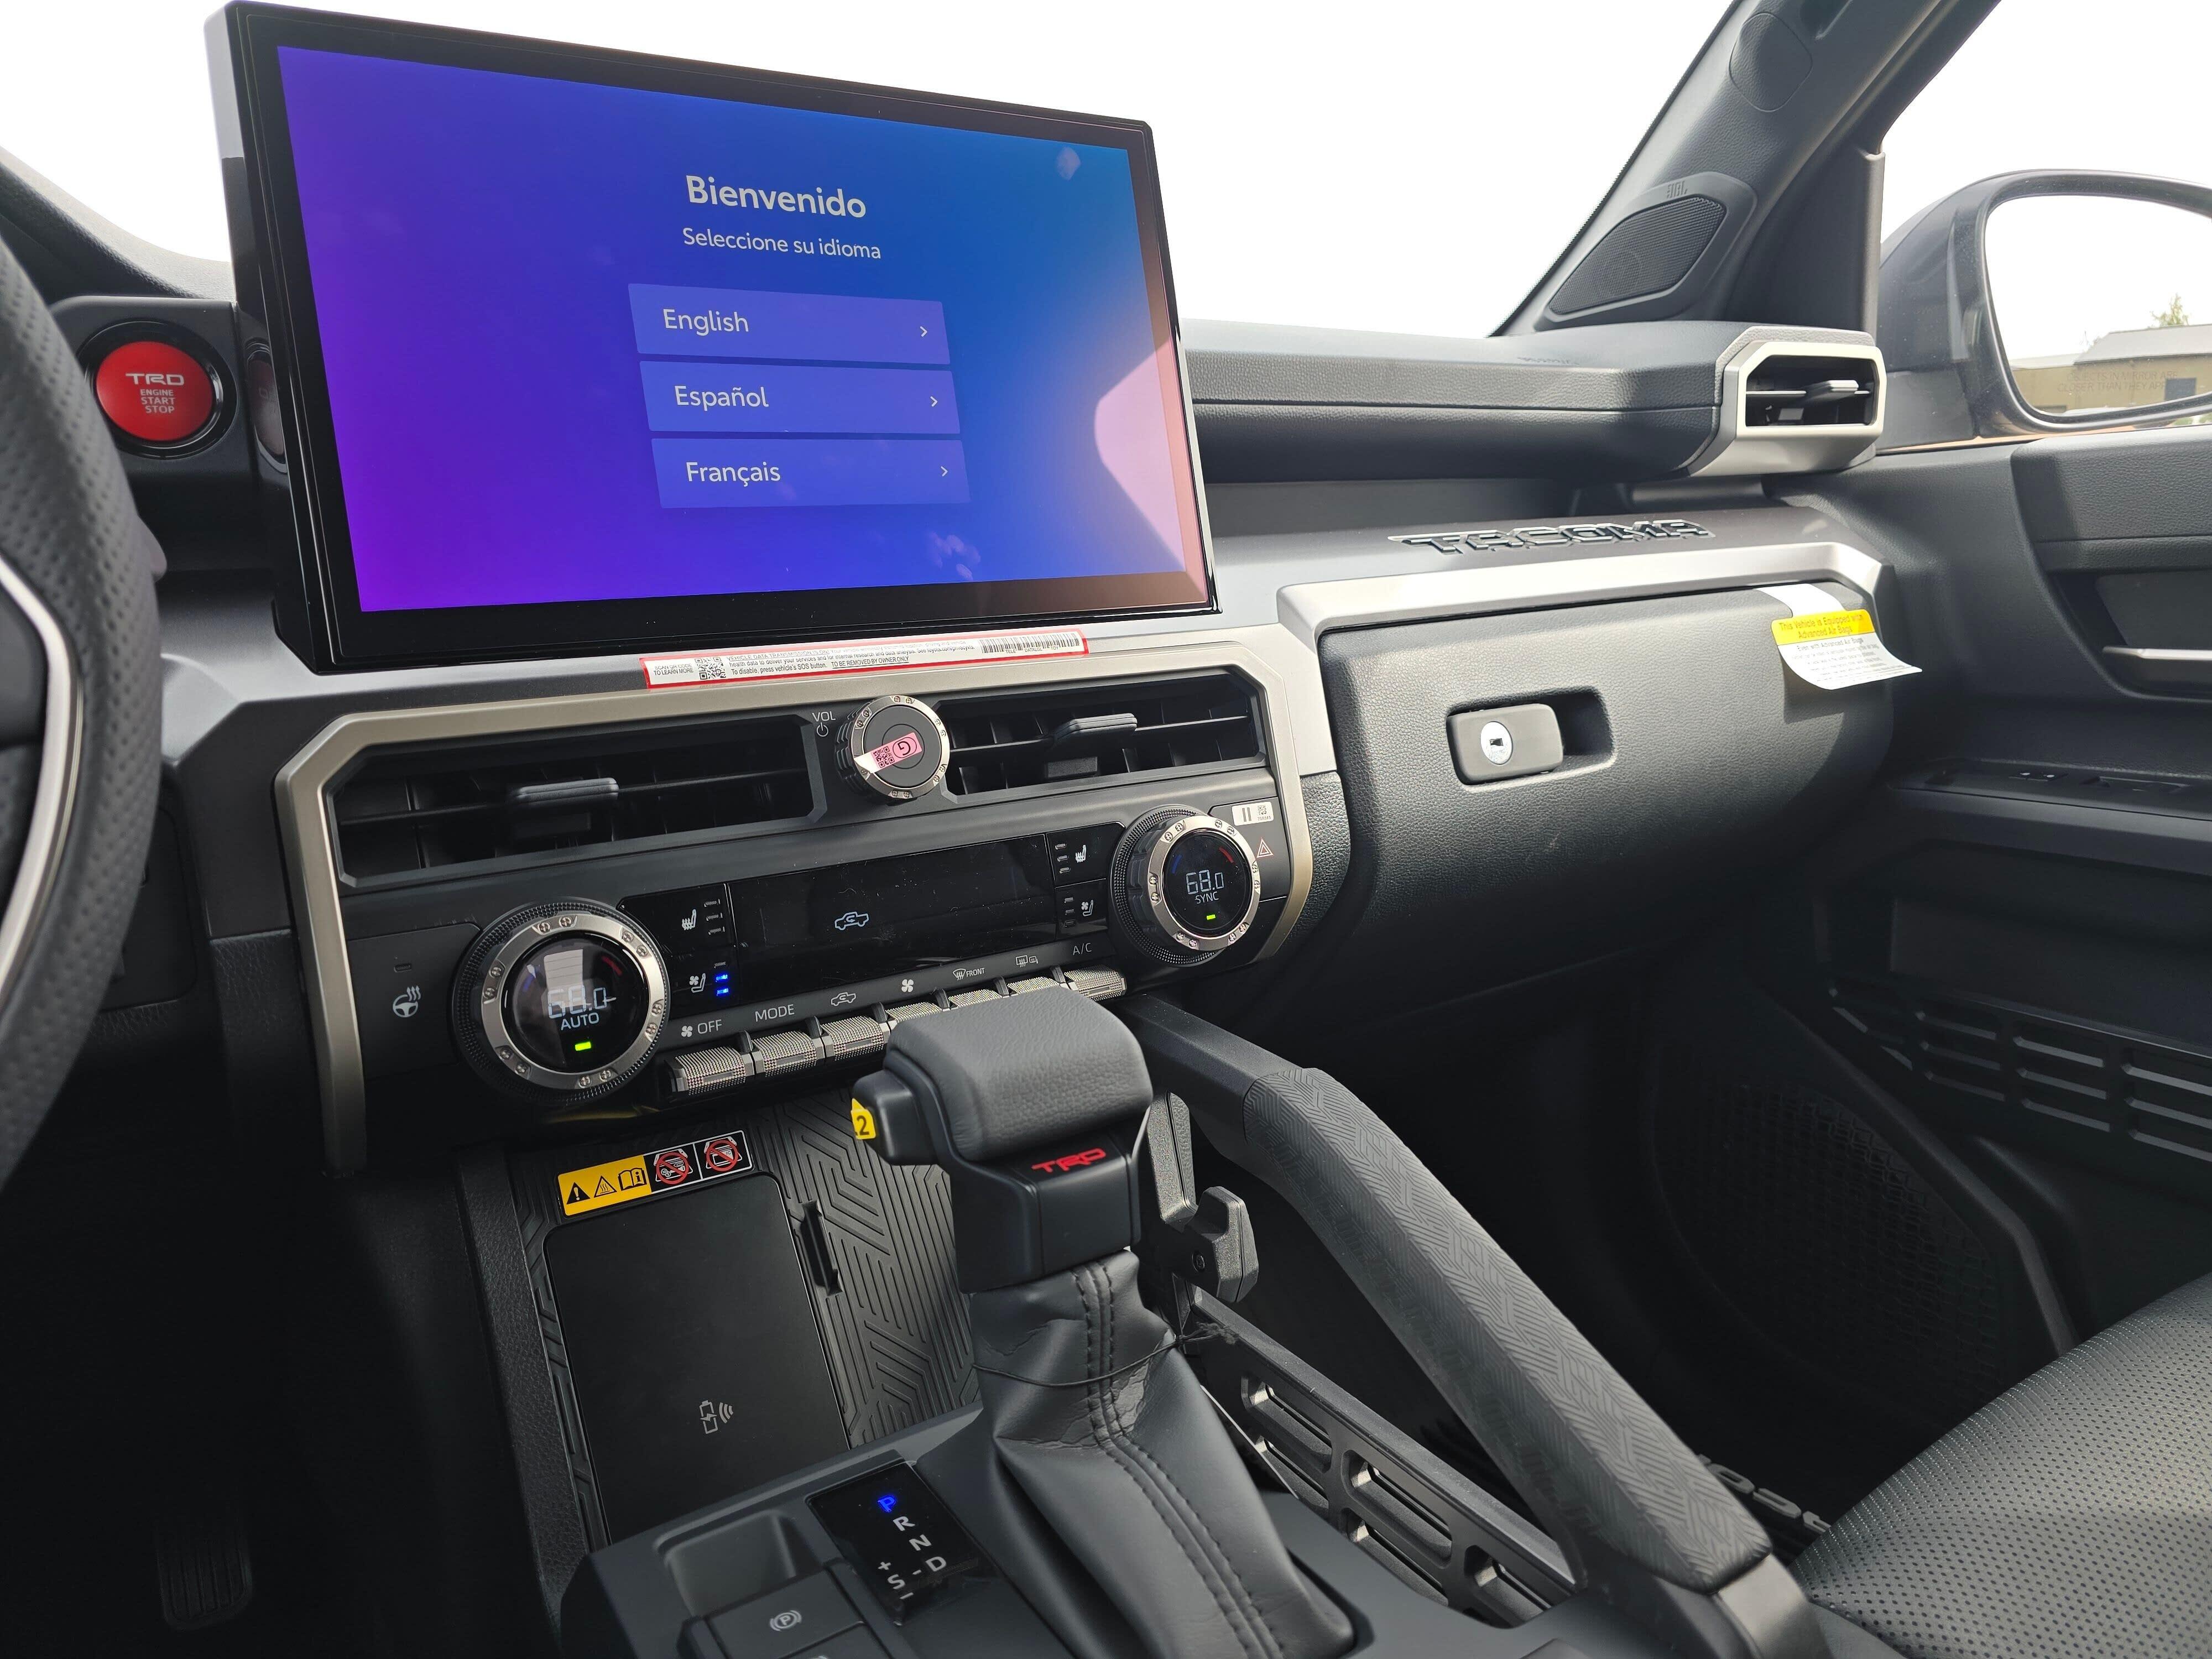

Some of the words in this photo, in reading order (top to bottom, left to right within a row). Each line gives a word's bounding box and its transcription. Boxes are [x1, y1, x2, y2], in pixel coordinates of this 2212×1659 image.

[685, 175, 867, 218] Bienvenido
[682, 227, 789, 253] Seleccione
[793, 239, 815, 255] su
[818, 240, 881, 259] idioma
[663, 309, 749, 336] English
[125, 373, 185, 386] TRD
[139, 388, 174, 397] ENGINE
[674, 385, 769, 411] Español
[140, 397, 176, 405] START
[145, 405, 175, 414] STOP
[686, 461, 781, 487] Français
[1387, 519, 1716, 554] TACOMA
[1778, 622, 1793, 631] This
[1794, 620, 1816, 629] Vehicle
[1798, 628, 1828, 639] Advanced
[1828, 627, 1837, 635] Air
[760, 666, 774, 674] press
[774, 664, 797, 672] vehicle's
[812, 711, 836, 722] VOL
[897, 740, 911, 756] G
[1186, 869, 1225, 895] 68.0
[1194, 891, 1219, 905] SYNC
[1072, 942, 1093, 956] A/C
[966, 966, 986, 978] FRONT
[547, 985, 607, 1019] 68.0
[754, 1004, 795, 1022] MODE
[561, 1012, 599, 1031] AUTO
[697, 1019, 723, 1034] OFF
[855, 1114, 870, 1136] 2
[1031, 1147, 1107, 1173] TRD
[878, 1494, 898, 1513] P
[893, 1516, 916, 1531] R
[909, 1534, 932, 1551] N
[926, 1556, 947, 1572] D
[887, 1574, 906, 1590] S
